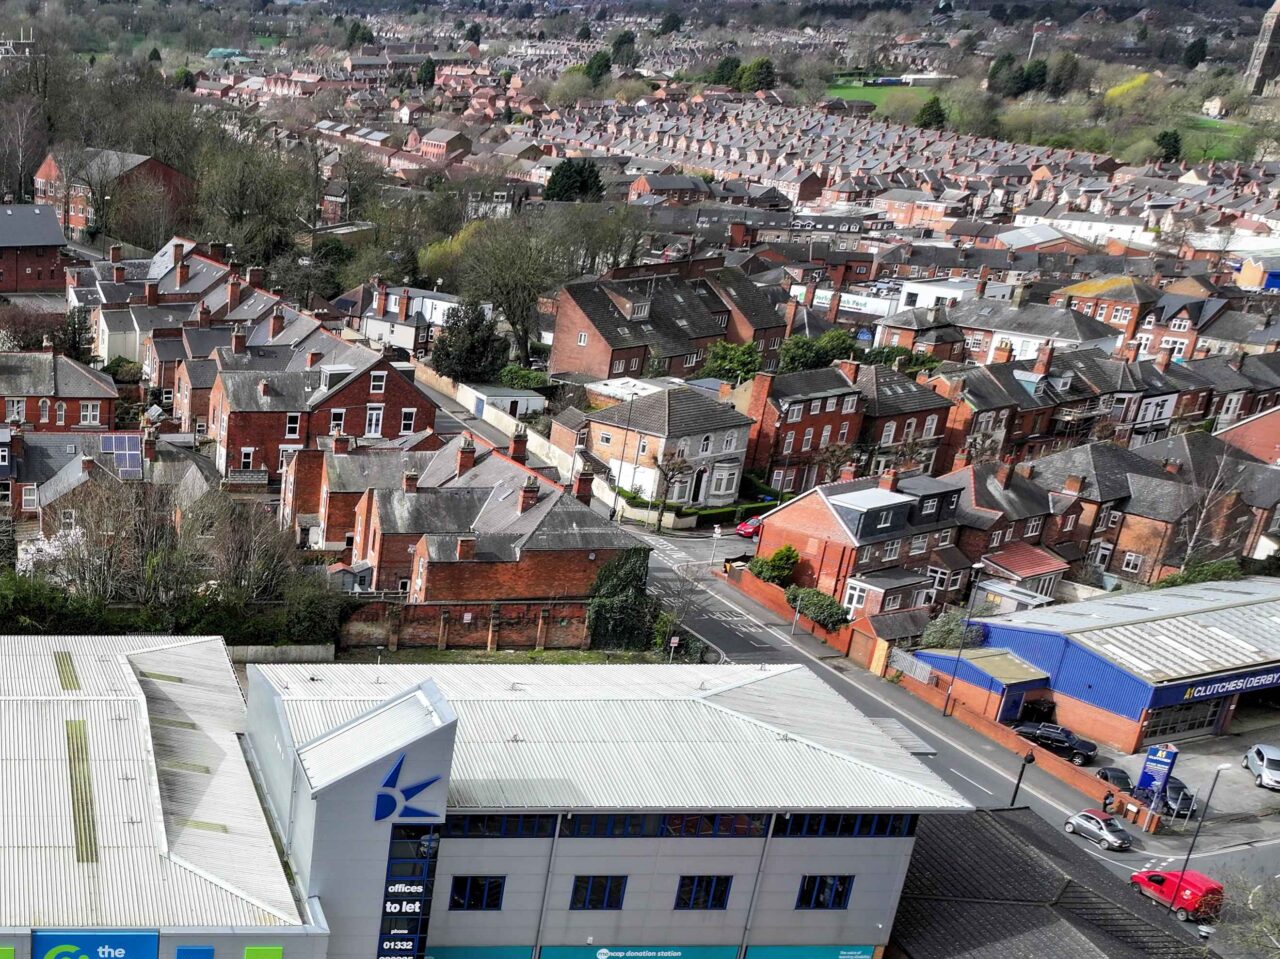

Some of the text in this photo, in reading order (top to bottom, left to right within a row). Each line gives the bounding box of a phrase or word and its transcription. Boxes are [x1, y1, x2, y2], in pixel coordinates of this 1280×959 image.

[1184, 687, 1195, 699] A1
[388, 884, 423, 892] offices
[385, 901, 420, 912] to let
[383, 941, 413, 949] 01332
[97, 944, 126, 958] the
